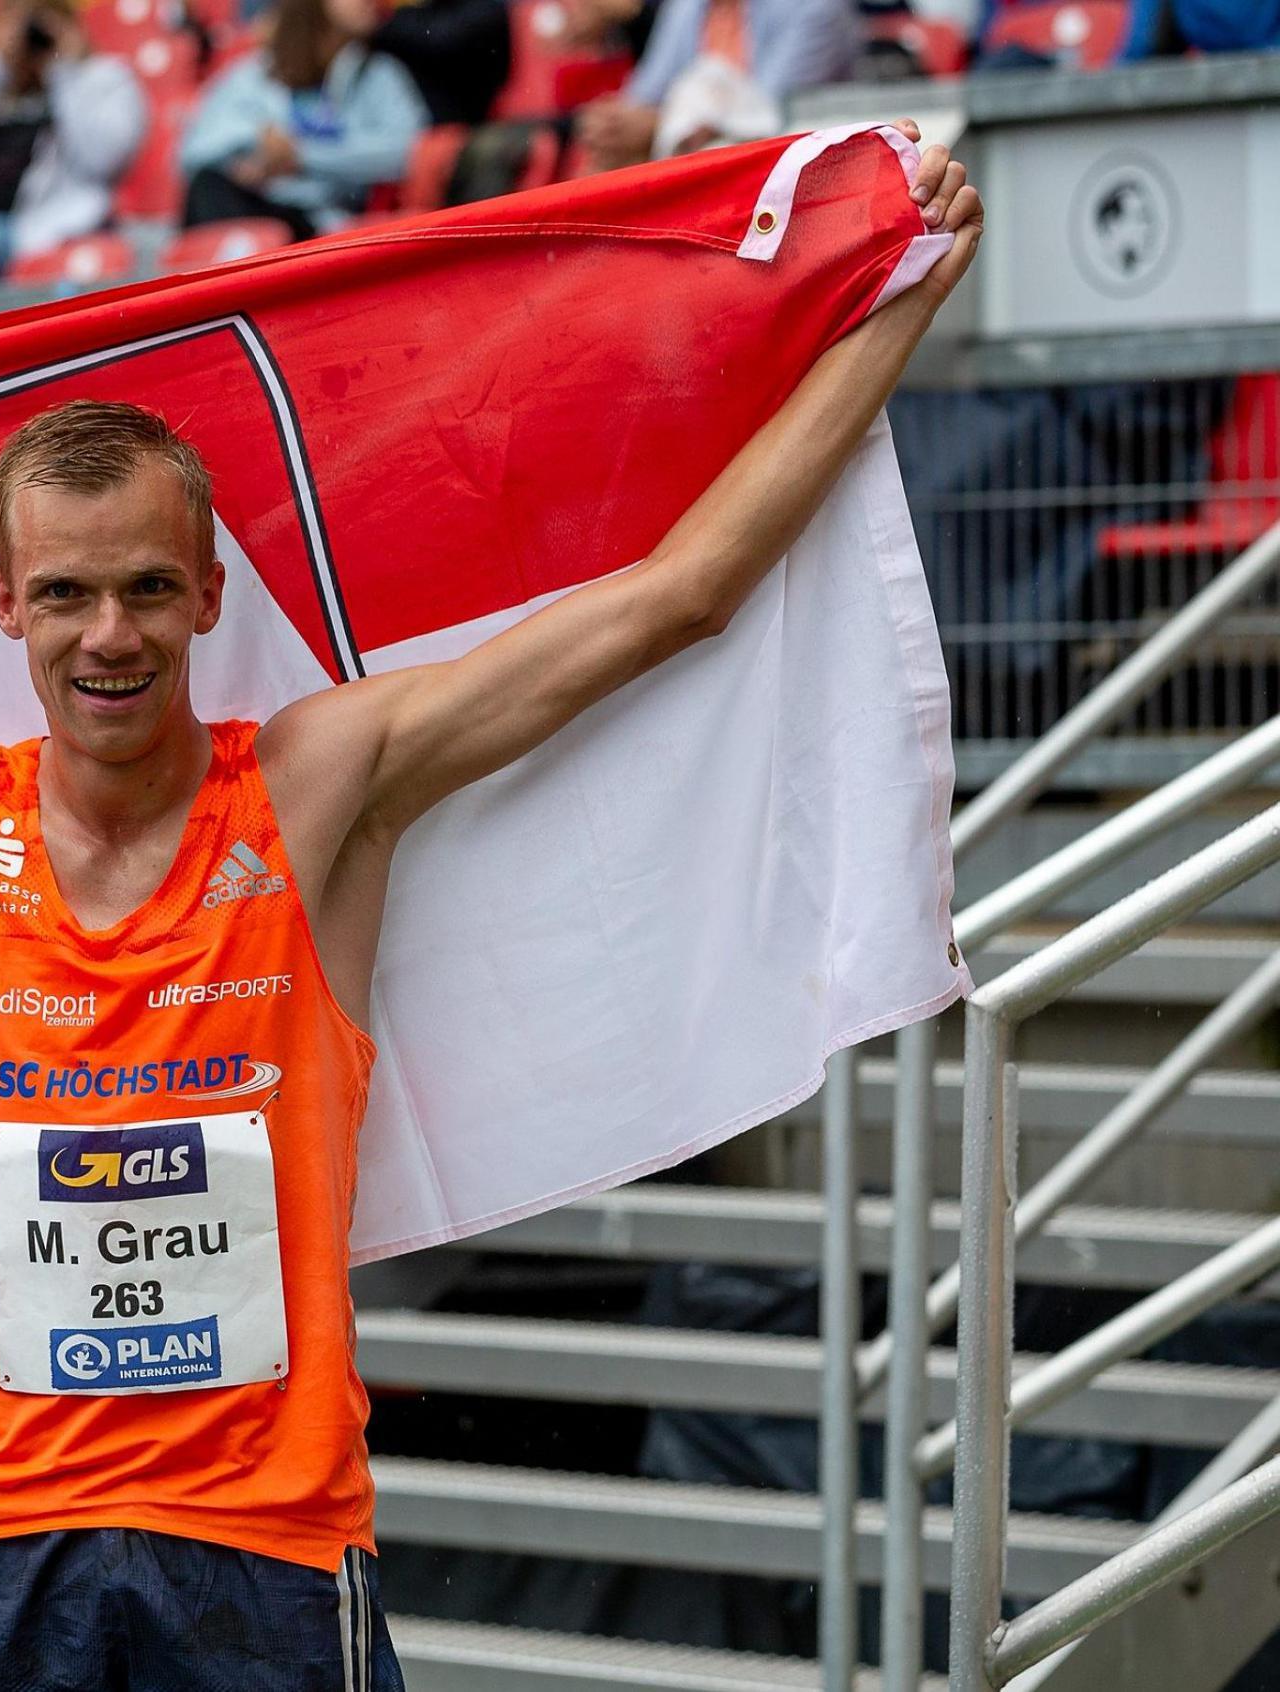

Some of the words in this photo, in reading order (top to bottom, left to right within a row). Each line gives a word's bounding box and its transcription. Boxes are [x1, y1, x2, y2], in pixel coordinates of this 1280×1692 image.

[202, 873, 287, 910] adidas
[46, 1013, 95, 1027] zentrum
[45, 1053, 249, 1098] HÖCHSTADT
[123, 1145, 190, 1185] GLS
[26, 1220, 79, 1265] M.
[97, 1220, 229, 1265] Grau
[90, 1280, 164, 1319] 263
[117, 1331, 212, 1364] PLAN
[120, 1364, 213, 1379] INTERNATIONAL
